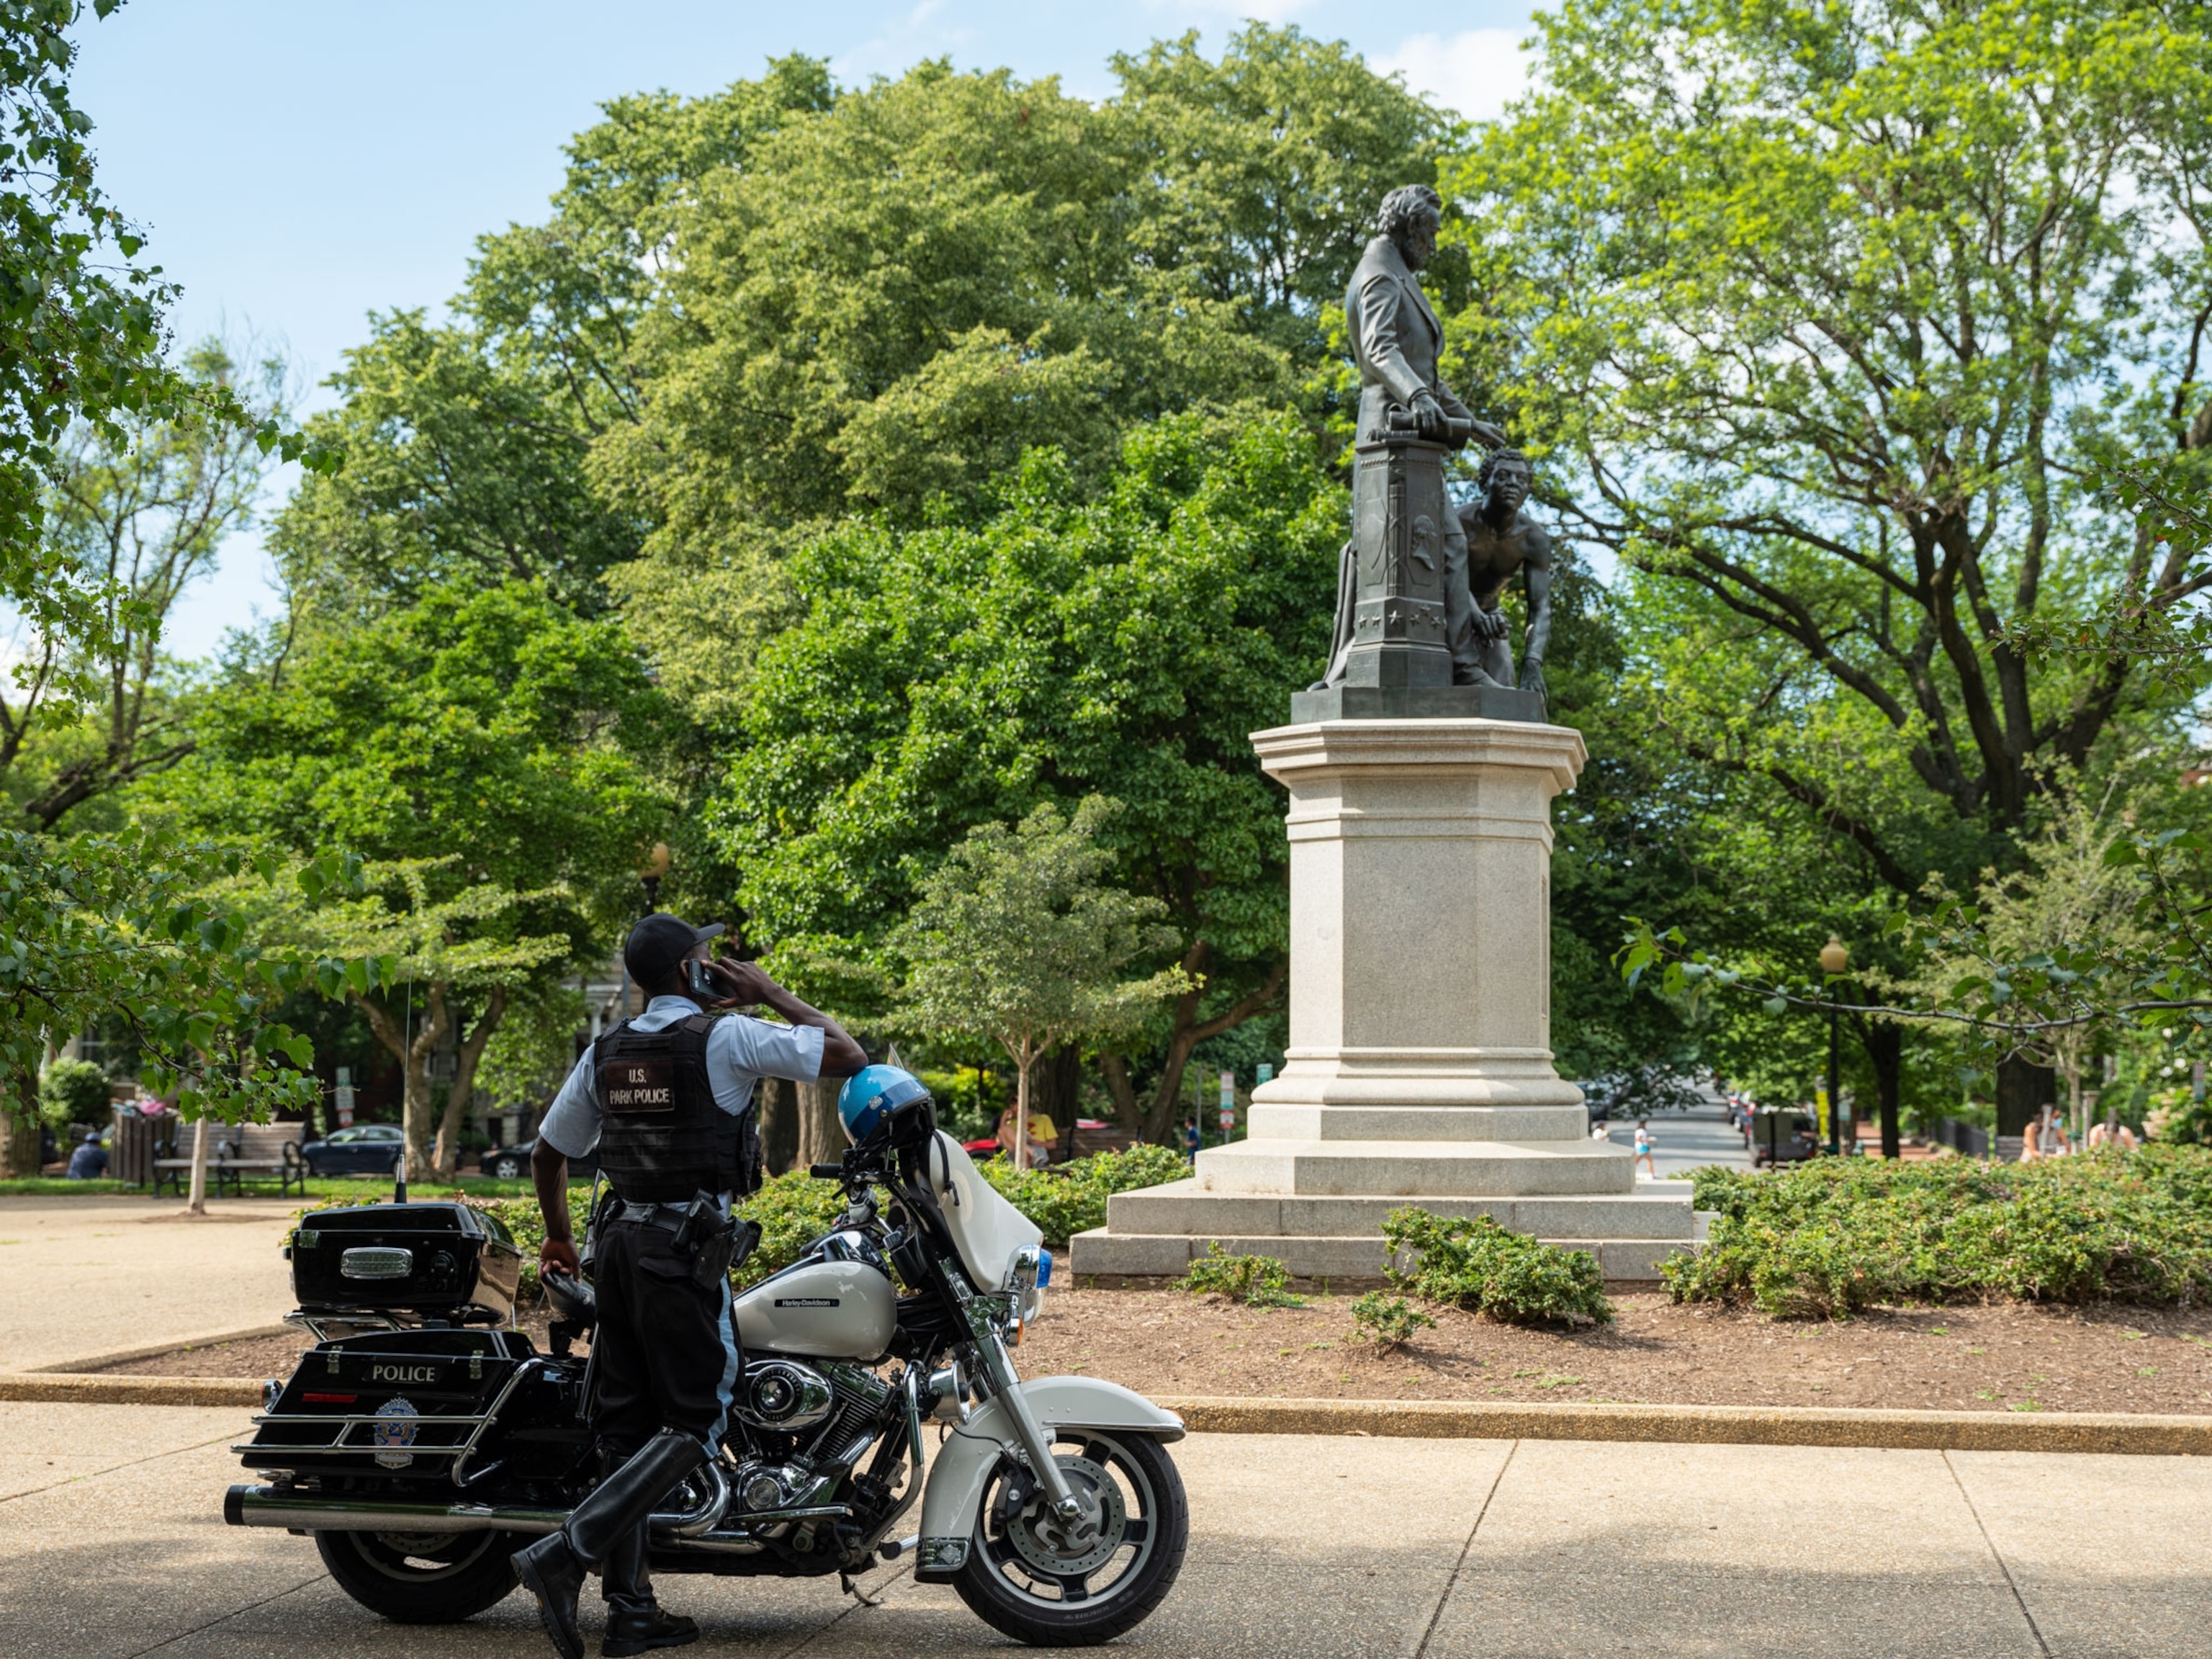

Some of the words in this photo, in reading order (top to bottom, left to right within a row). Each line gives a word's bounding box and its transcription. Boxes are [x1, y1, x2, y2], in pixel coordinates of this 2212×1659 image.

[629, 1069, 647, 1083] U.S.
[609, 1089, 633, 1105] PARK
[634, 1088, 670, 1104] POLICE
[372, 1365, 436, 1382] POLICE
